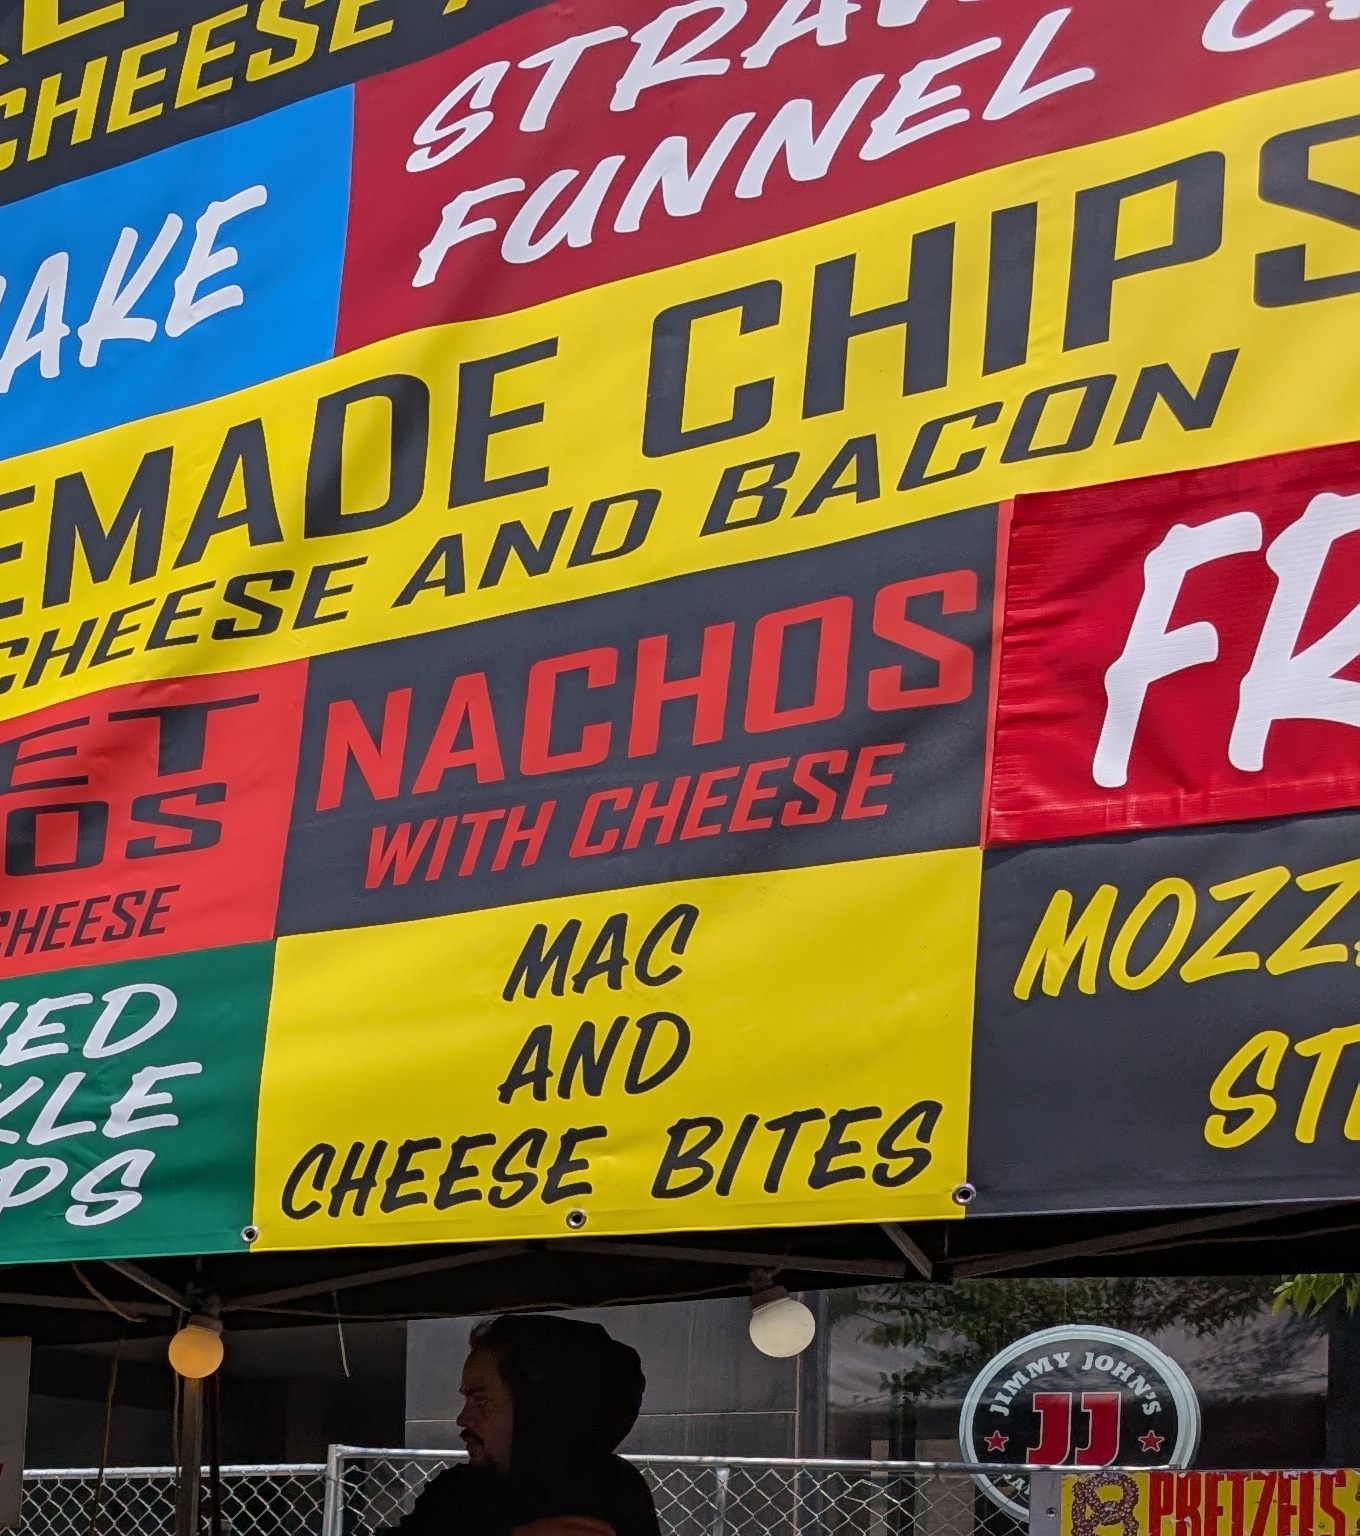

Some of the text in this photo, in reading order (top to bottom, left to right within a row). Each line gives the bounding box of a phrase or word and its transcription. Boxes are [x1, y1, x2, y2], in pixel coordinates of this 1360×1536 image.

[411, 8, 1095, 288] FUNNEL
[641, 112, 1360, 460] CHIPS
[390, 487, 660, 609] AND
[700, 348, 1242, 538] BACON
[314, 569, 980, 812] NACHOS
[363, 742, 906, 891] WITH CHEESE
[502, 902, 700, 1003] MAC
[1013, 864, 1360, 1001] MOZZ
[496, 1011, 691, 1106] AND
[281, 1099, 946, 1222] CHEESE BITES
[990, 1351, 1162, 1417] JIMMY JOHN'S
[1026, 1392, 1122, 1466] JJ
